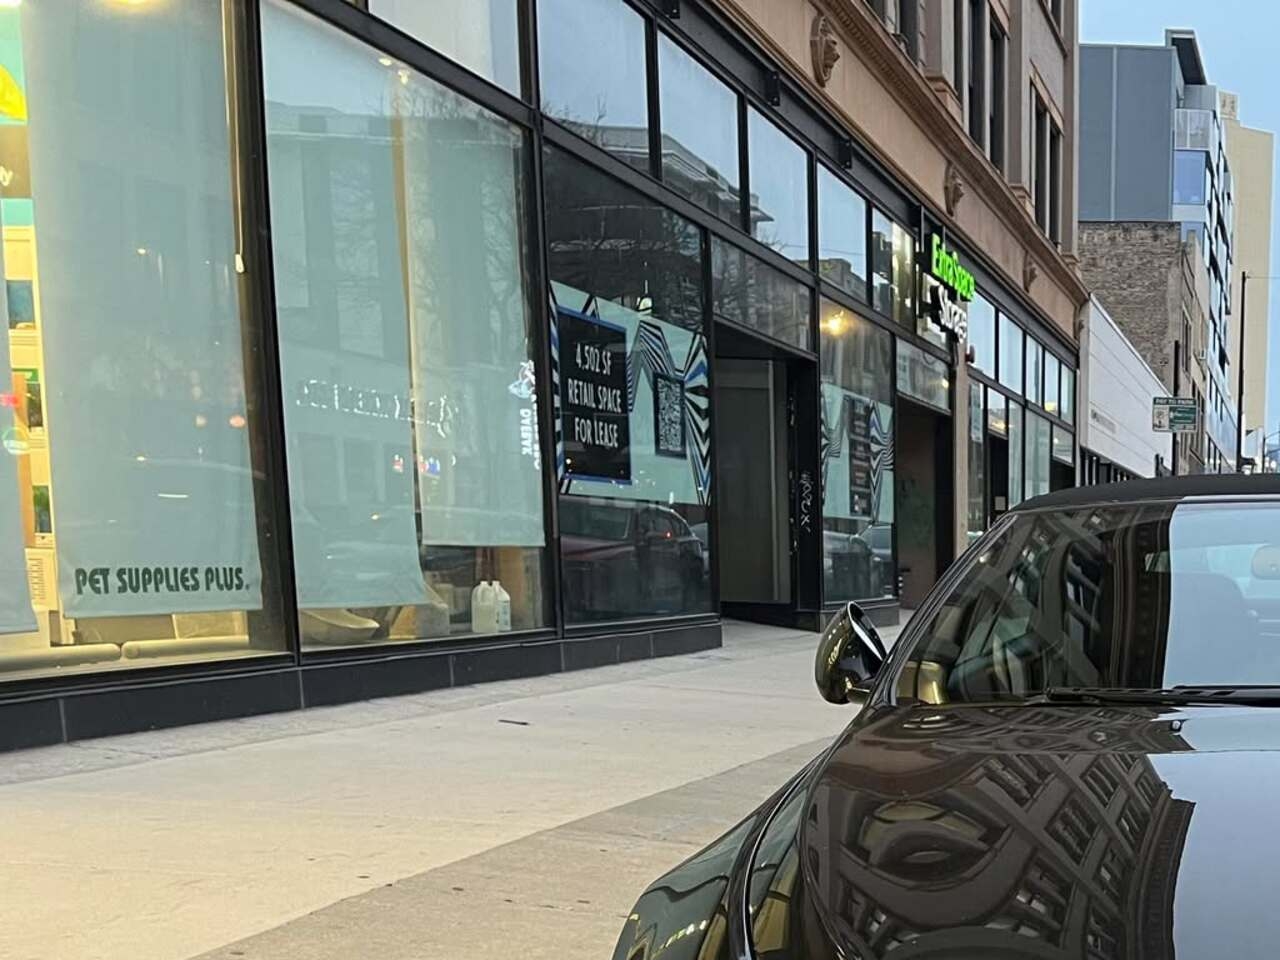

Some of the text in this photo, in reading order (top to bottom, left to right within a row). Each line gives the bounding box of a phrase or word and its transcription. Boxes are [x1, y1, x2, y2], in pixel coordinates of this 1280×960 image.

[602, 351, 611, 375] SF
[568, 378, 622, 413] RETAIL SPACE
[575, 417, 619, 448] FOR LEASE
[75, 567, 110, 595] PET
[116, 567, 200, 593] SUPPLIES
